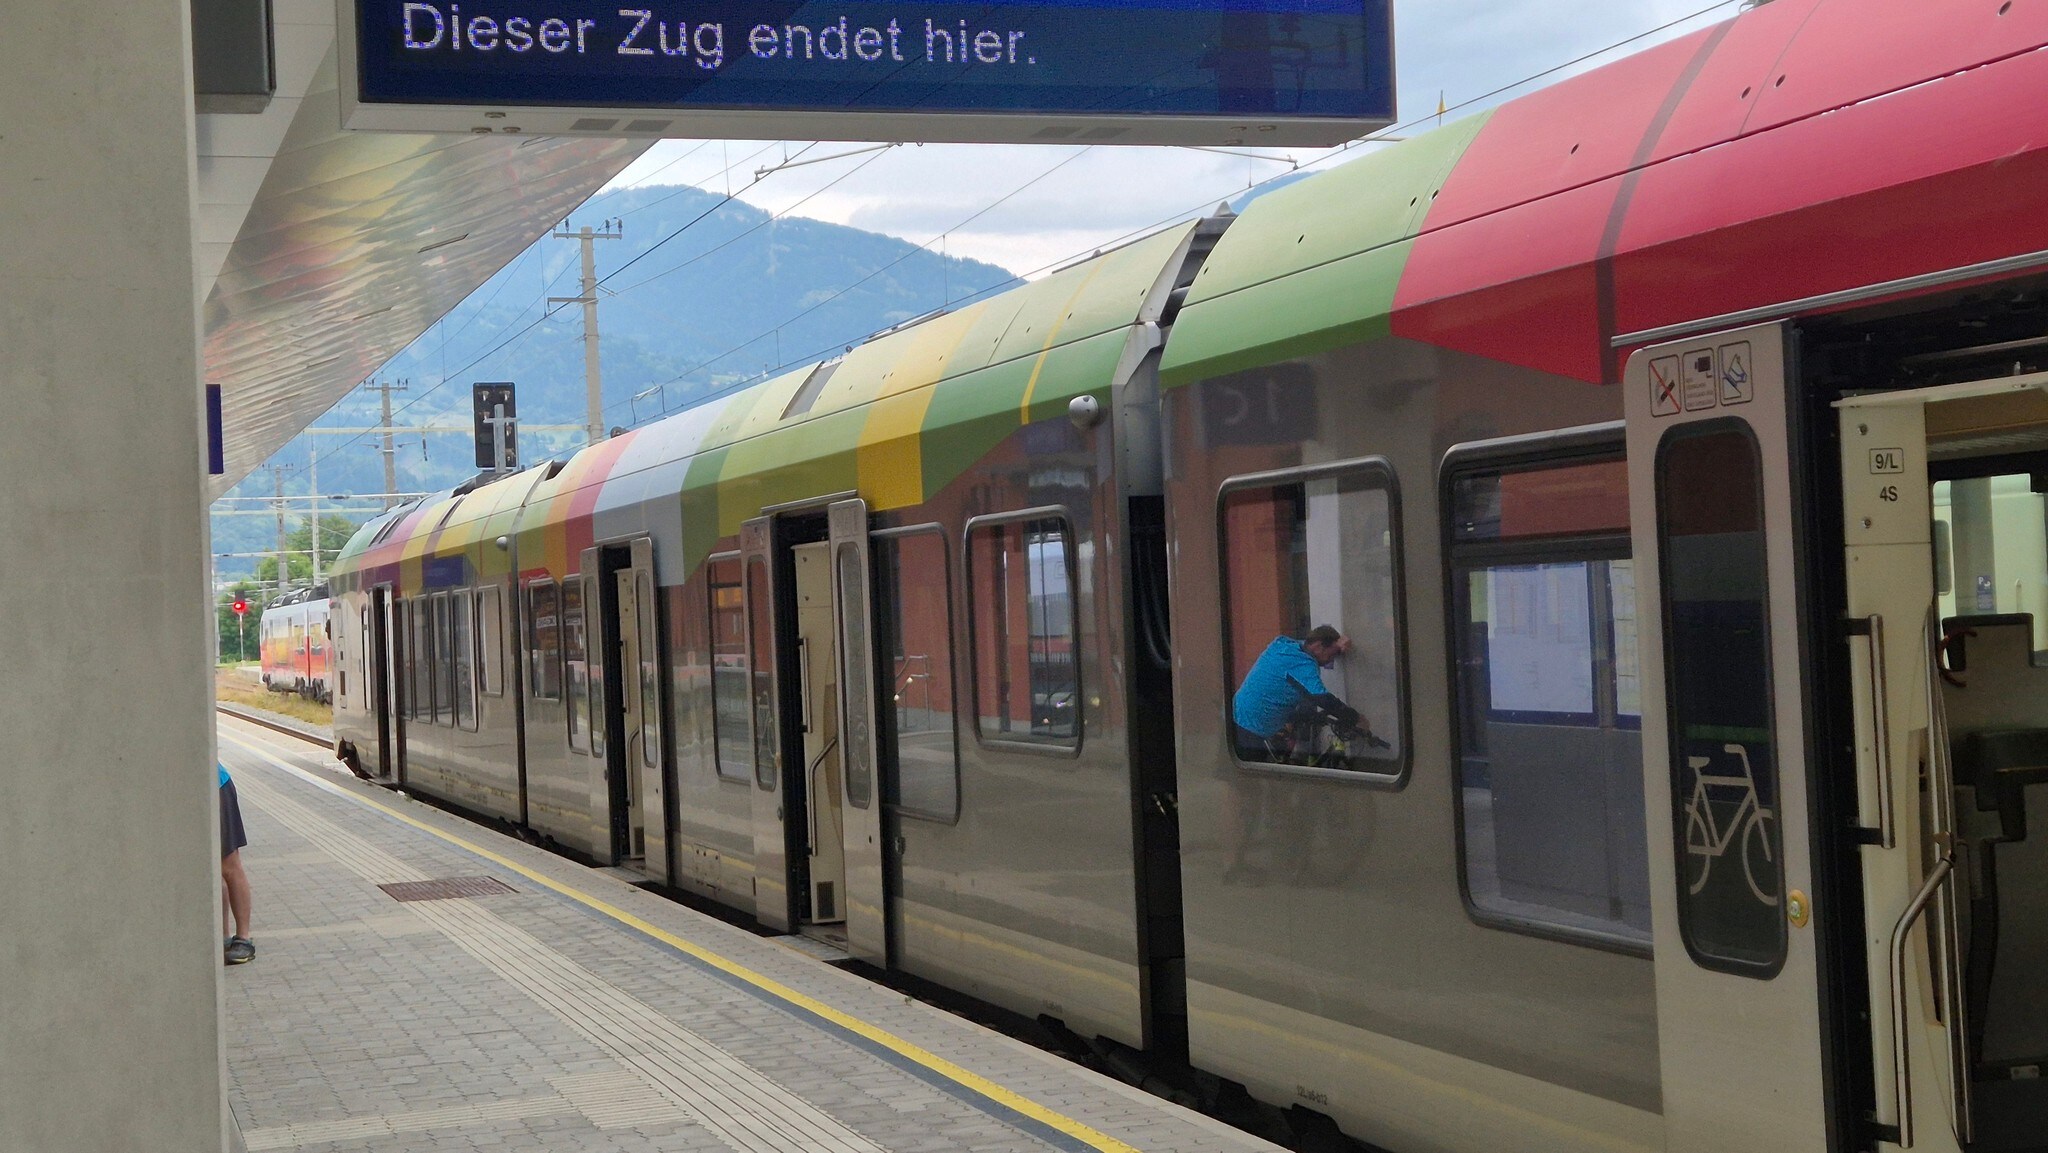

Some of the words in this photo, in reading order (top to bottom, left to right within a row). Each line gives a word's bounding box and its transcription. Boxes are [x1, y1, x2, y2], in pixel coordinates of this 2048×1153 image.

[403, 2, 596, 53] Dieser
[617, 9, 723, 69] Zug
[748, 16, 903, 60] endet
[925, 18, 1036, 64] hier.
[1875, 453, 1899, 469] 9/L
[1880, 486, 1898, 501] 4S
